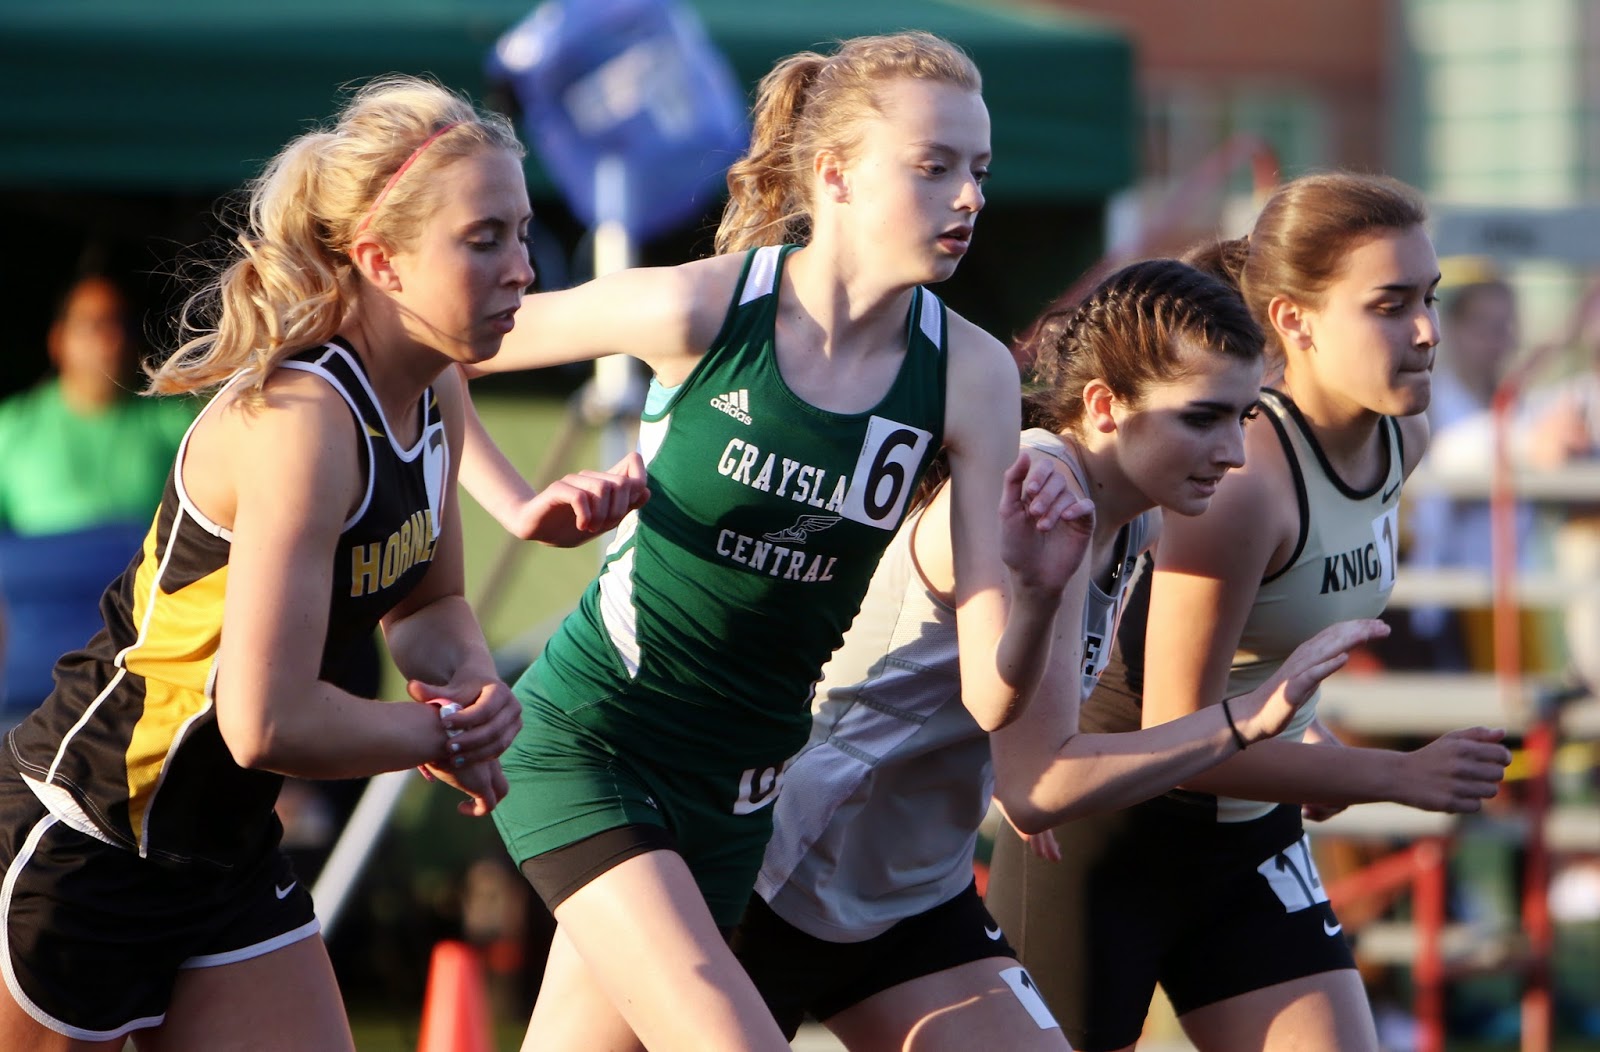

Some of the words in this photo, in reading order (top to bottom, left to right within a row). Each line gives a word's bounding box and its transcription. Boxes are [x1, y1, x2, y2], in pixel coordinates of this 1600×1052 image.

[709, 397, 753, 426] adidas
[863, 428, 919, 521] 6
[350, 509, 438, 598] HORNE
[716, 528, 838, 582] CENTRAL
[1319, 542, 1382, 595] KNIG
